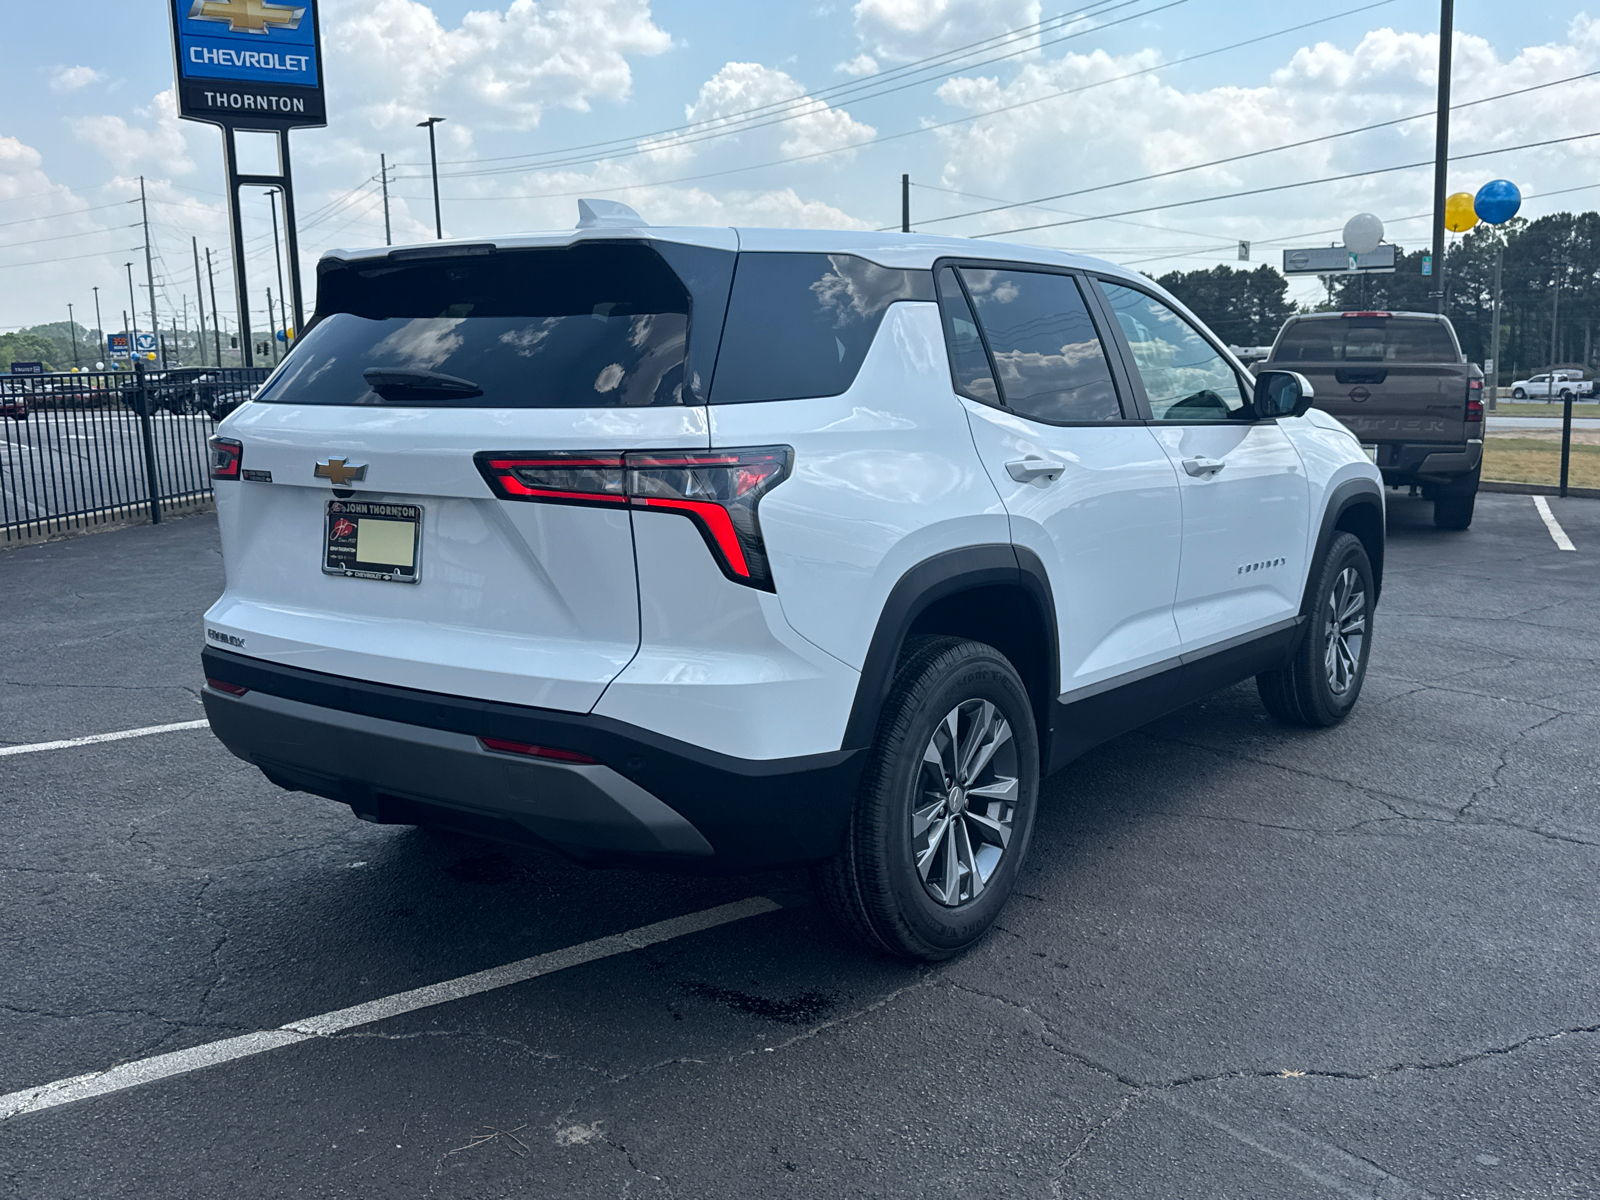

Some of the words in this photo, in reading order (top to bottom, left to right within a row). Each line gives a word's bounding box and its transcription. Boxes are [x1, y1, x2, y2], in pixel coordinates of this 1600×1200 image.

[190, 47, 309, 71] CHEVROLET
[204, 92, 304, 112] THORNTON
[347, 503, 367, 513] JOHN
[369, 505, 415, 517] THORNTON
[354, 571, 382, 580] CHEVROLET
